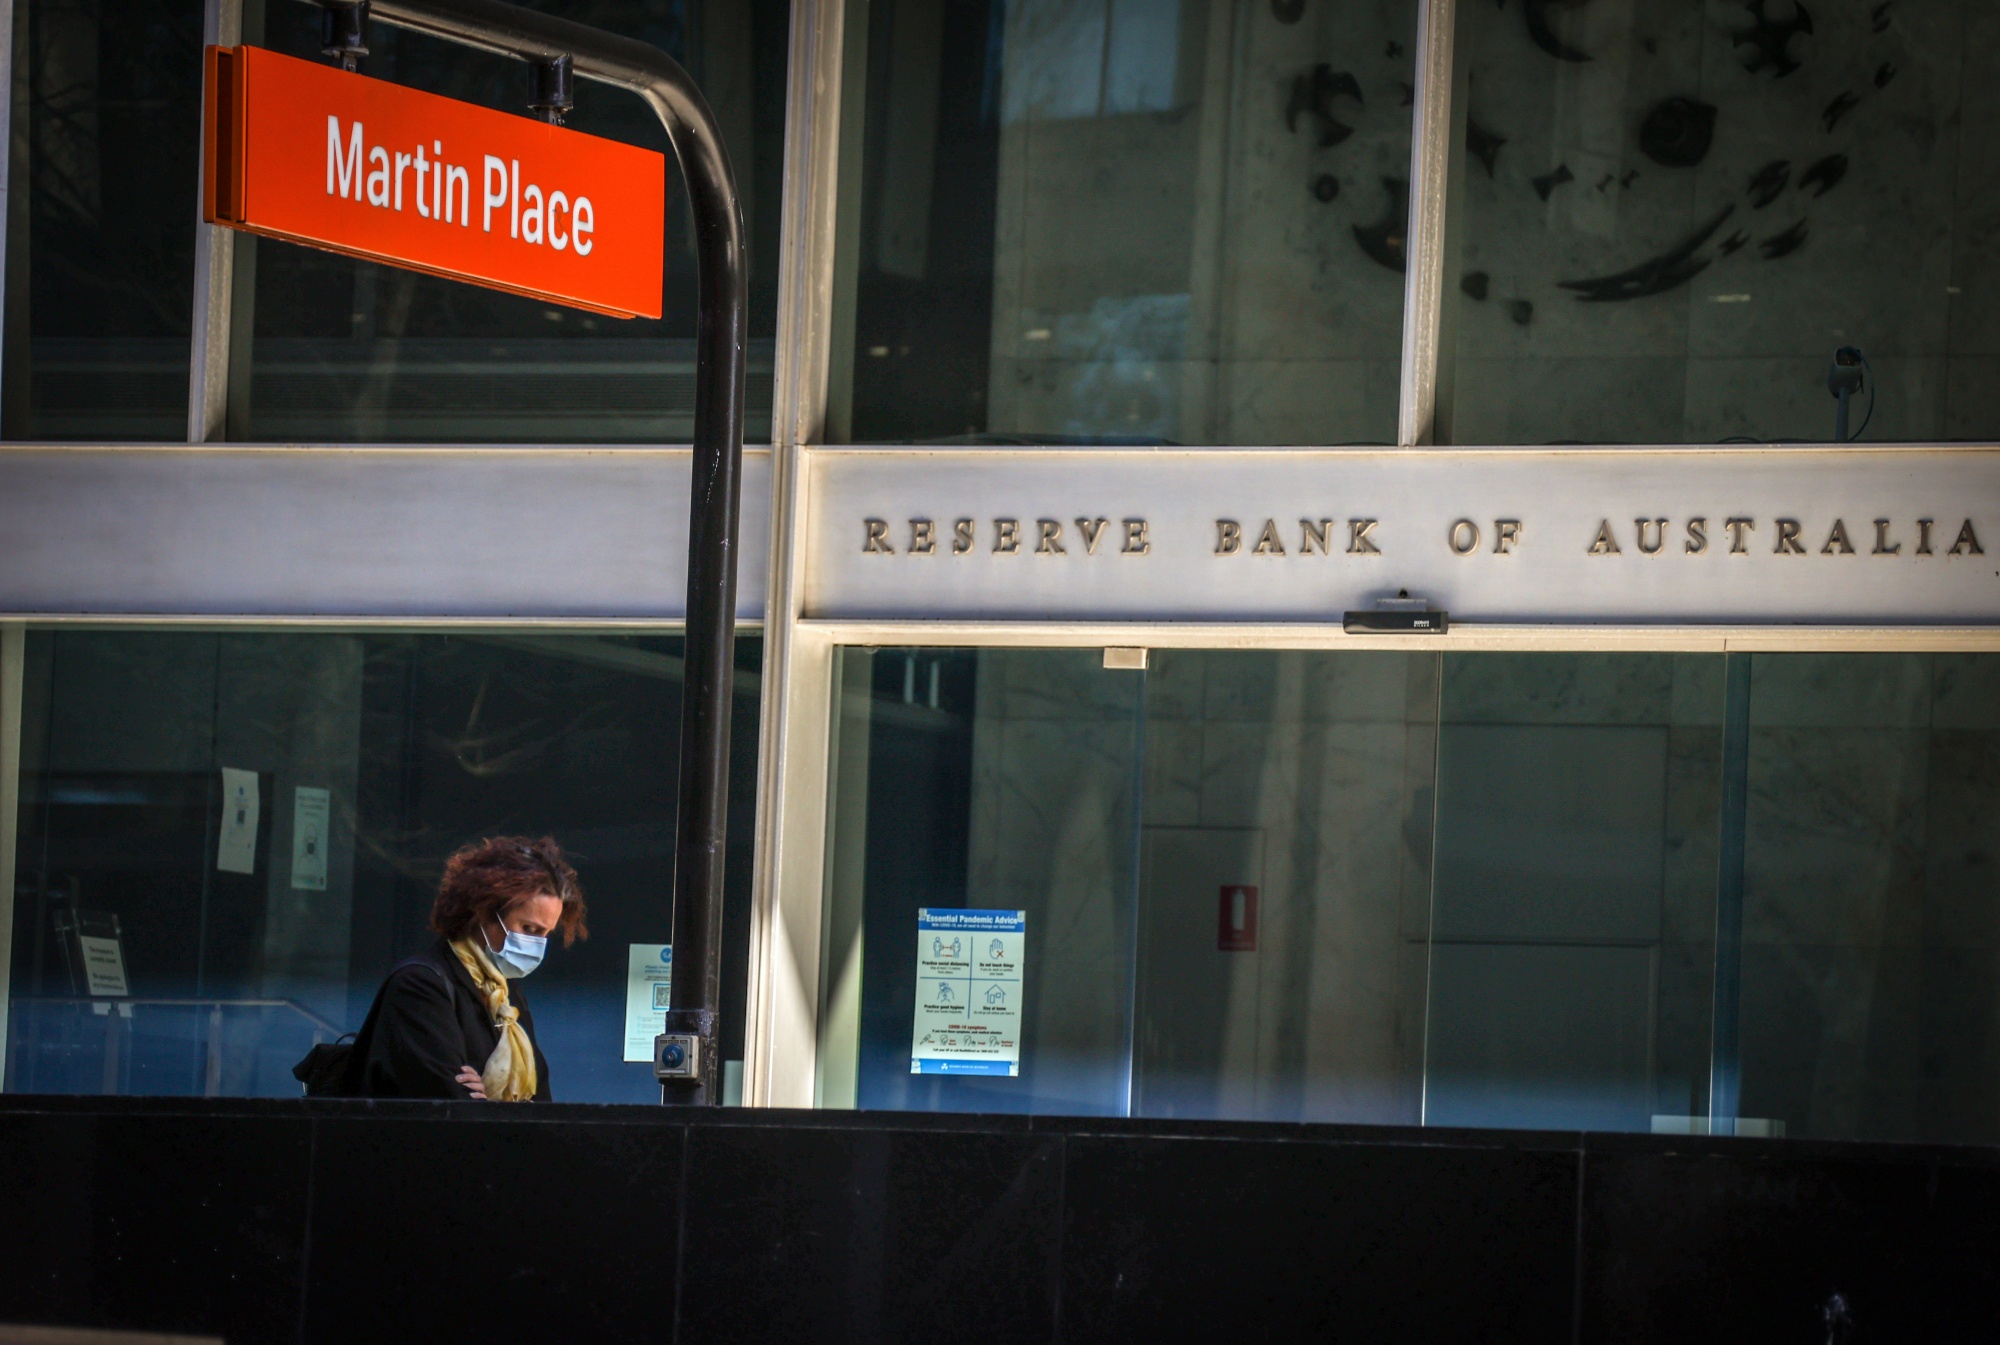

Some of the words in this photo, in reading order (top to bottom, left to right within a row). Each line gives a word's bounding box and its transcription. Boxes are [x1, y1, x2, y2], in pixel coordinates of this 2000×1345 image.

[326, 115, 469, 228] Martin
[483, 153, 594, 256] Place
[862, 518, 1150, 556] RESERVE
[1214, 518, 1382, 556] BANK
[1448, 518, 1523, 556] OF
[1587, 518, 1985, 556] AUSTRALIA
[926, 914, 958, 923] Essential
[959, 915, 994, 924] Pandemic
[995, 916, 1018, 925] Advice
